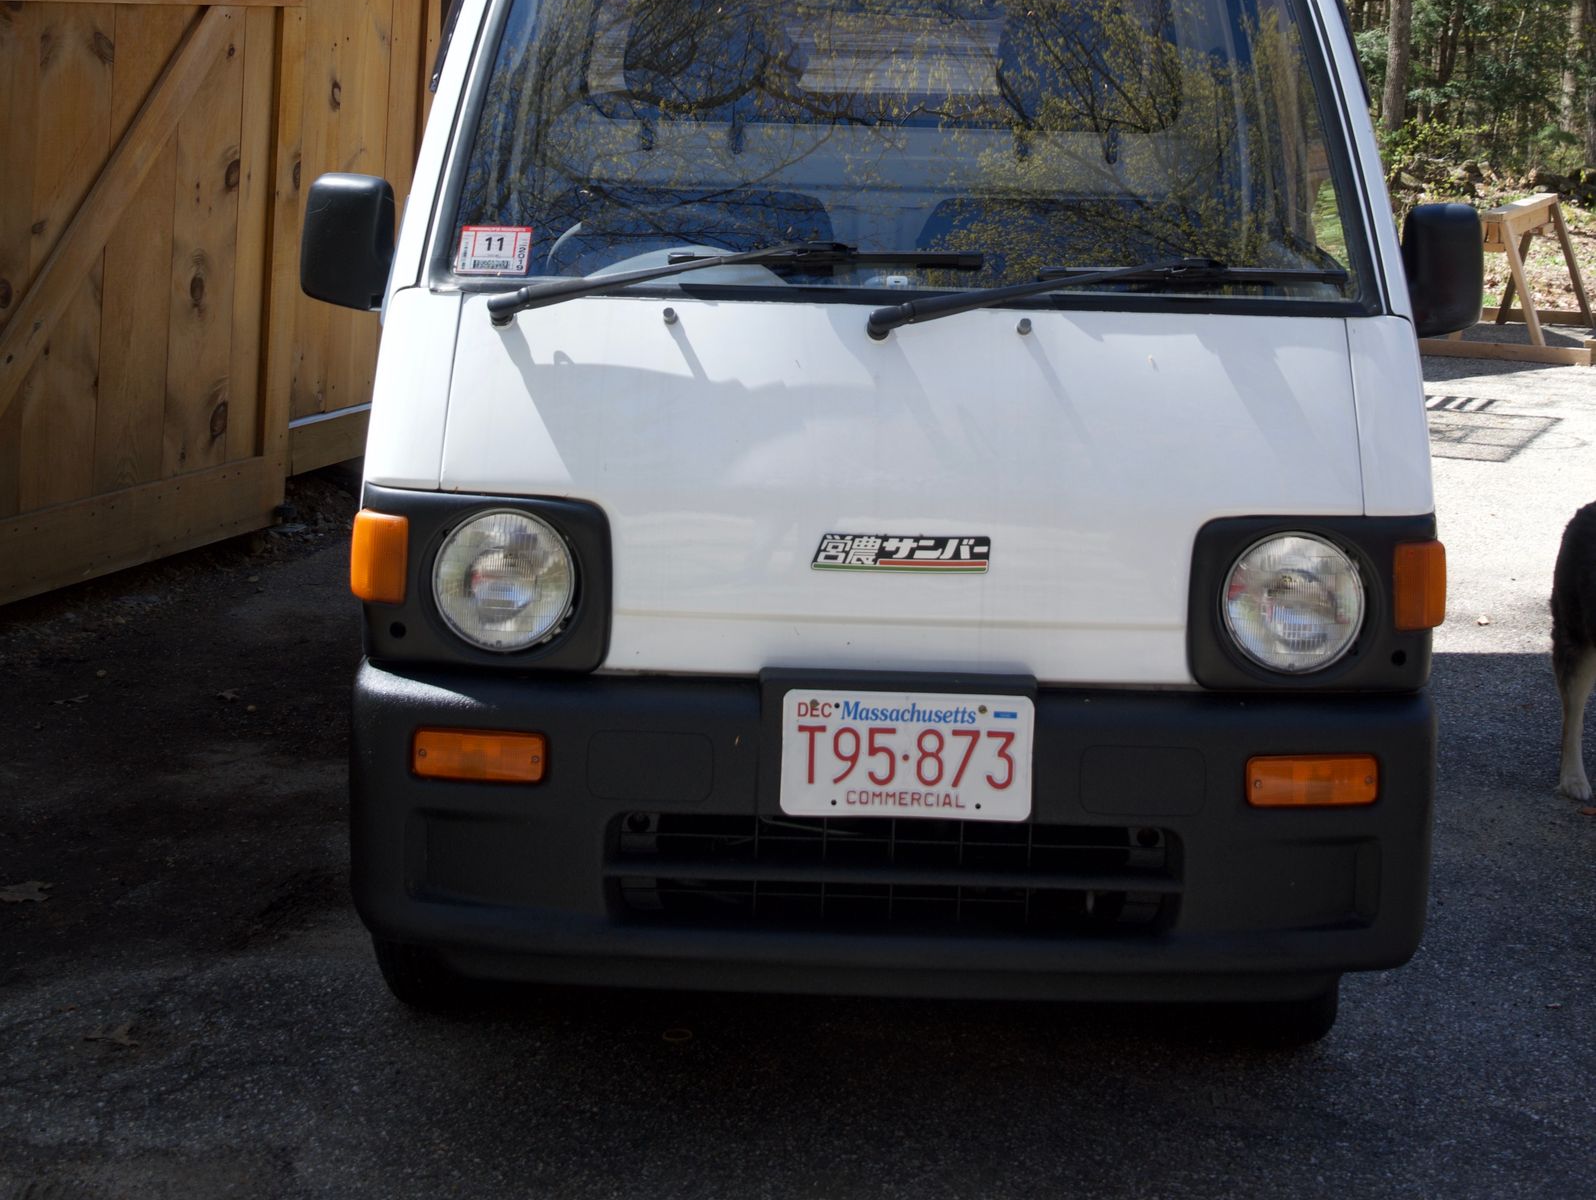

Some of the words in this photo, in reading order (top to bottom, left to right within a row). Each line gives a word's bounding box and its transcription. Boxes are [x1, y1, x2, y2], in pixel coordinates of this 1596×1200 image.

[485, 236, 504, 252] 11
[797, 701, 833, 719] DEC
[841, 700, 977, 725] Massachusetts
[846, 789, 967, 810] COMMERCIAL
